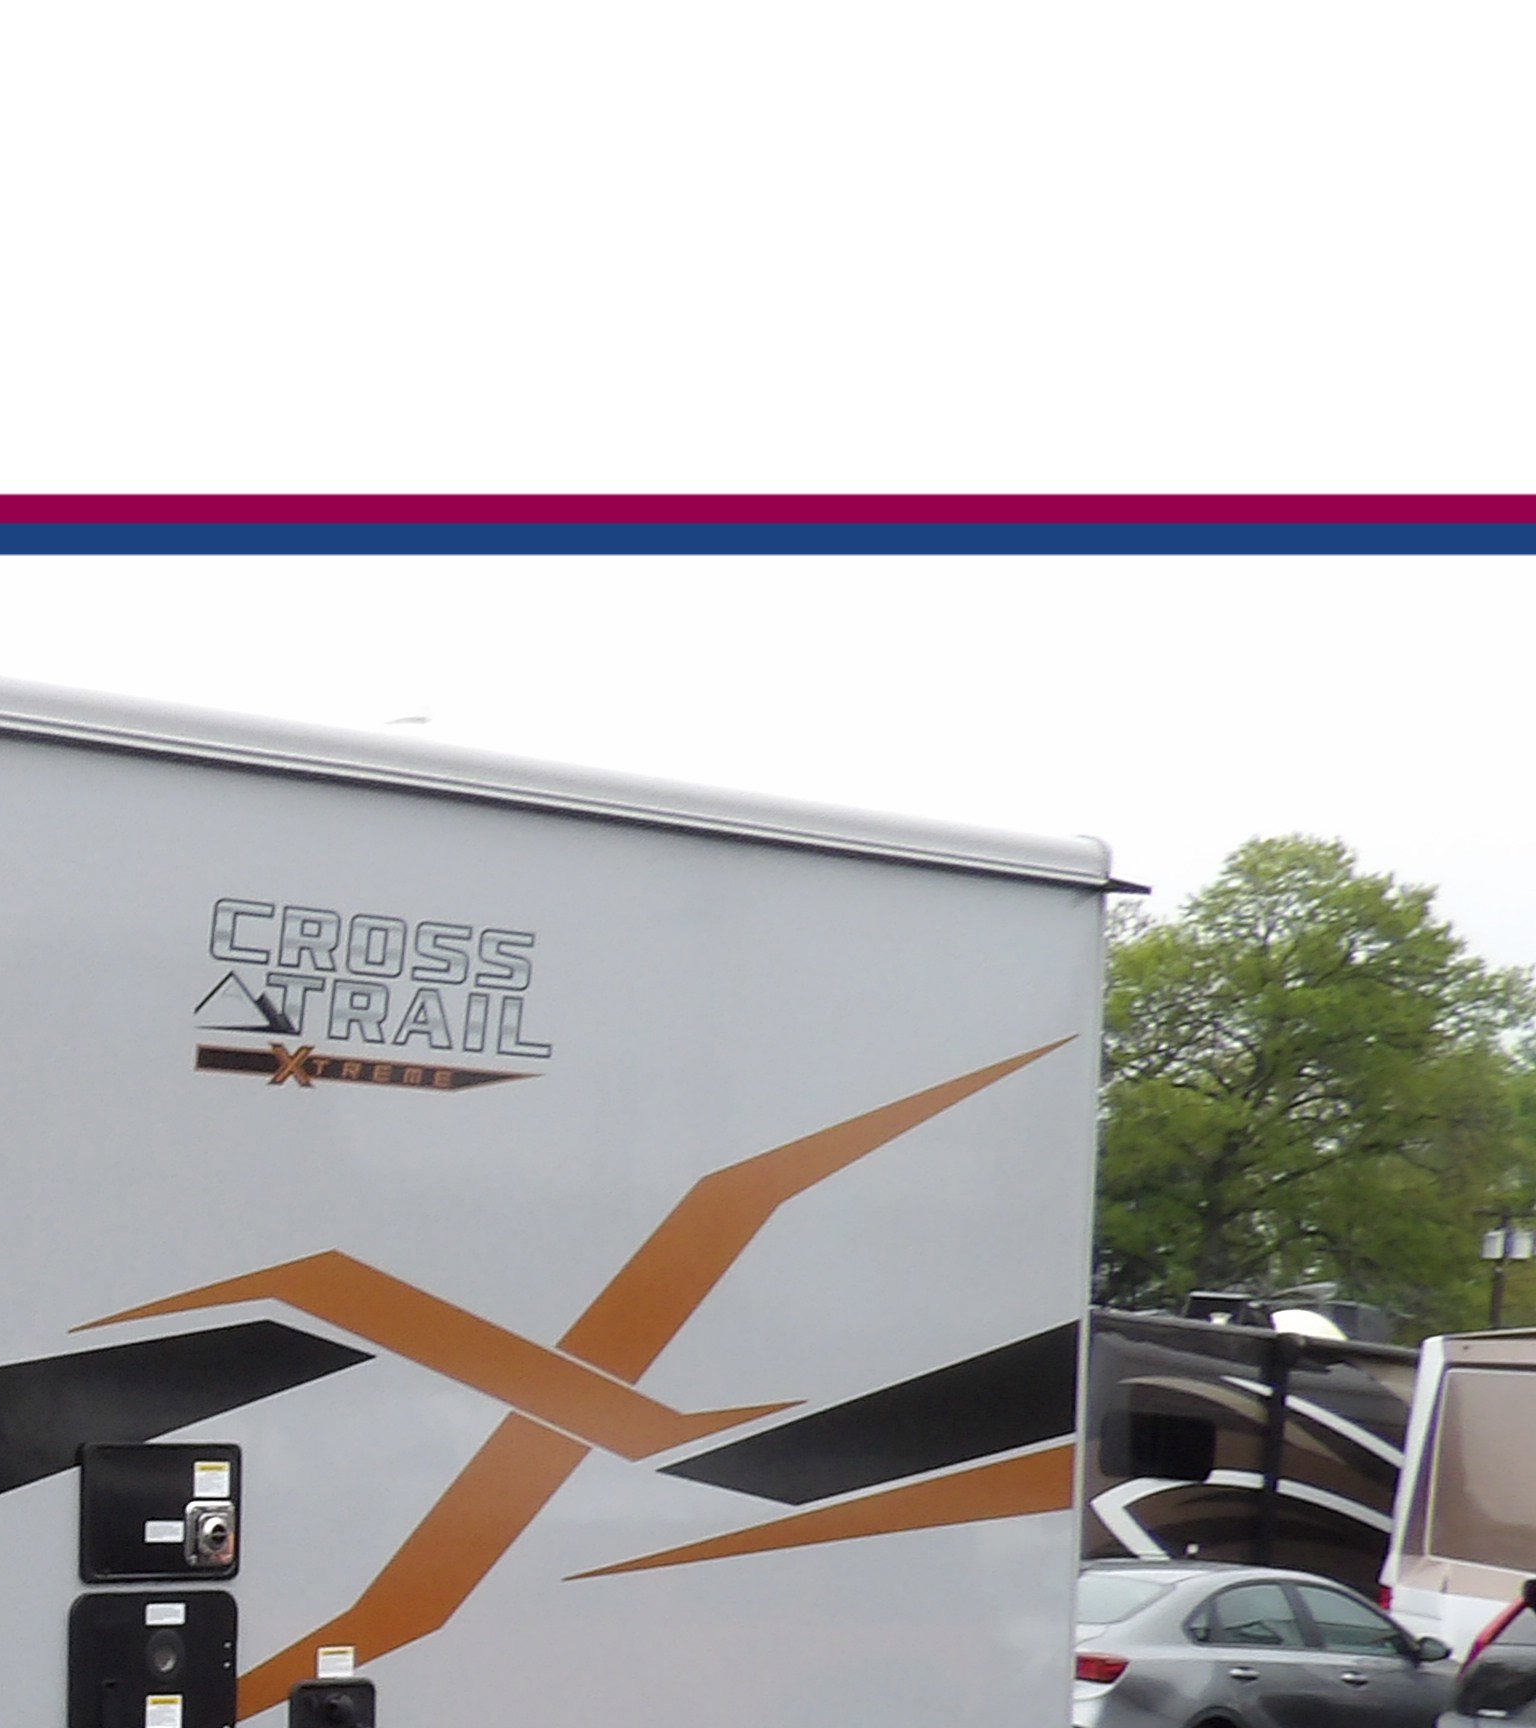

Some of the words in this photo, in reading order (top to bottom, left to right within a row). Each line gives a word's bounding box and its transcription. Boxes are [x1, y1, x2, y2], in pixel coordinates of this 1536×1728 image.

[209, 897, 536, 992] CROSS
[265, 972, 553, 1059] TRAIL
[265, 1042, 456, 1089] XTREME
